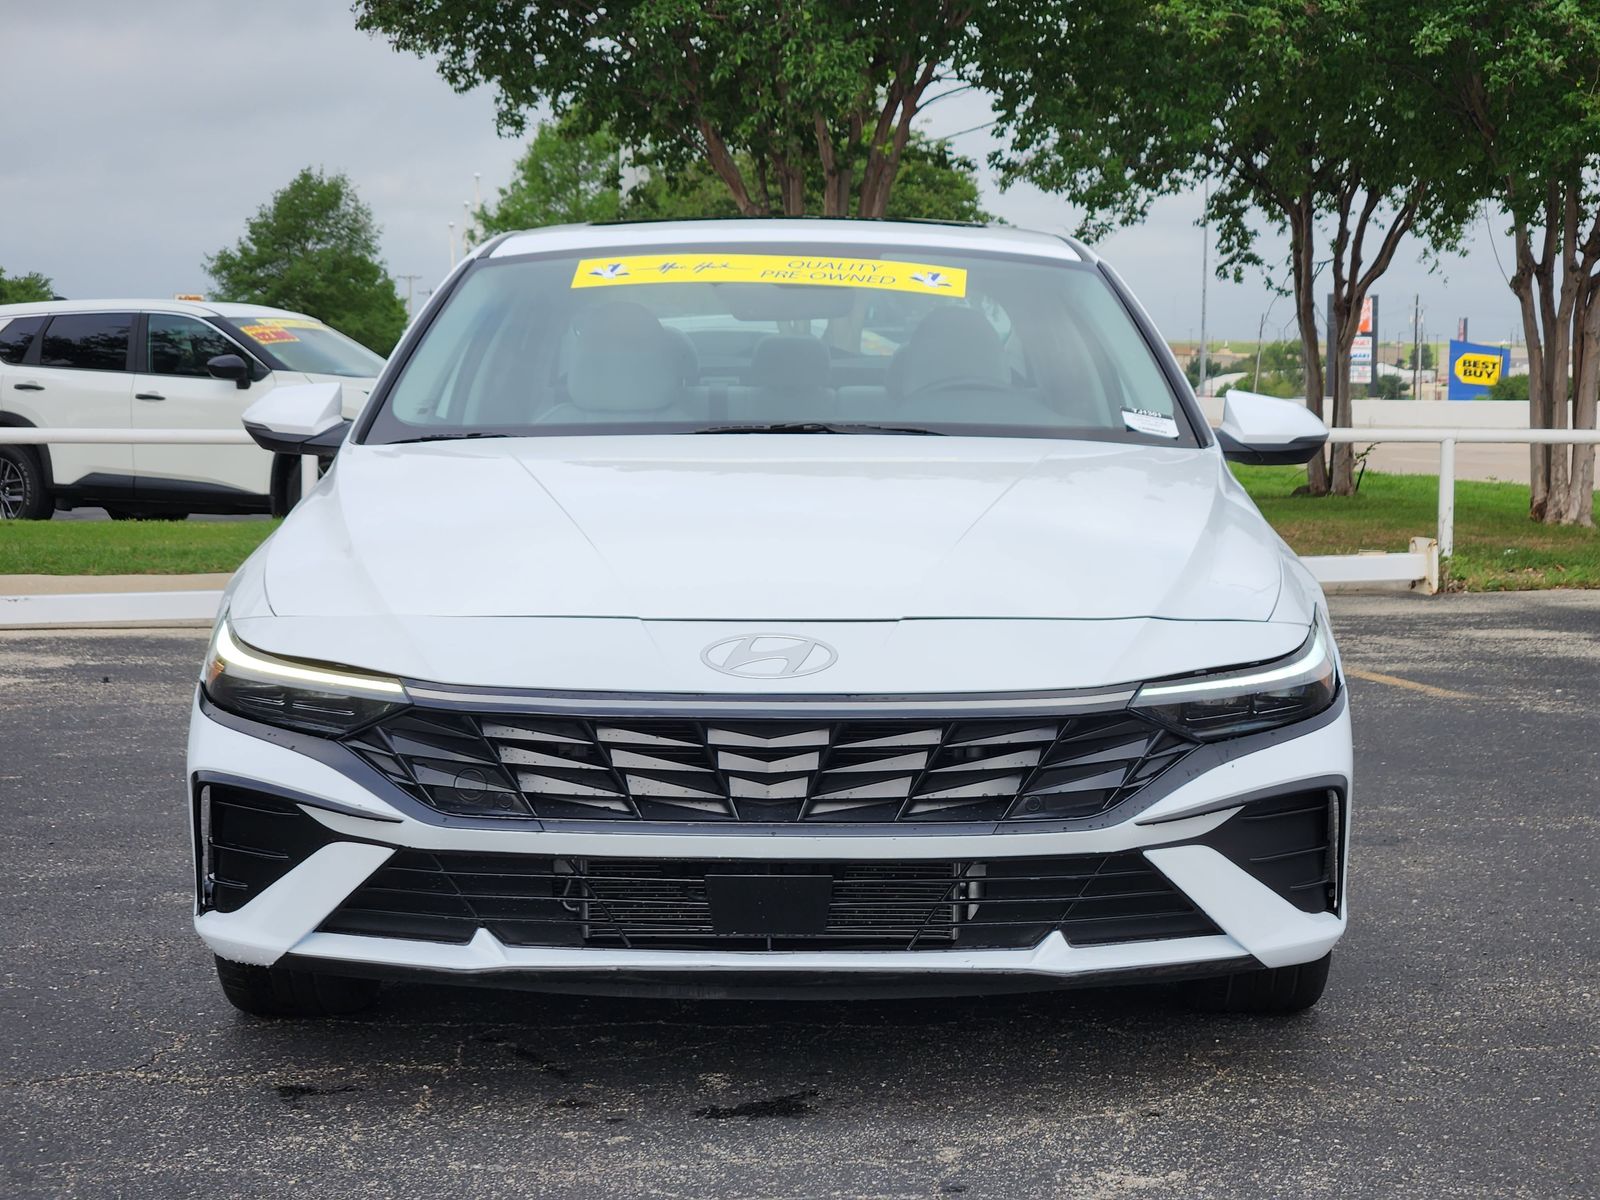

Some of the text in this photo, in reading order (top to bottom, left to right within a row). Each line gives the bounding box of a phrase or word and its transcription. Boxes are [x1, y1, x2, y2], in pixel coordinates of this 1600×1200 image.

[787, 259, 884, 273] QUALITY
[760, 269, 897, 286] PRE-OWNED
[1462, 359, 1498, 370] BEST
[1463, 369, 1494, 379] BUY
